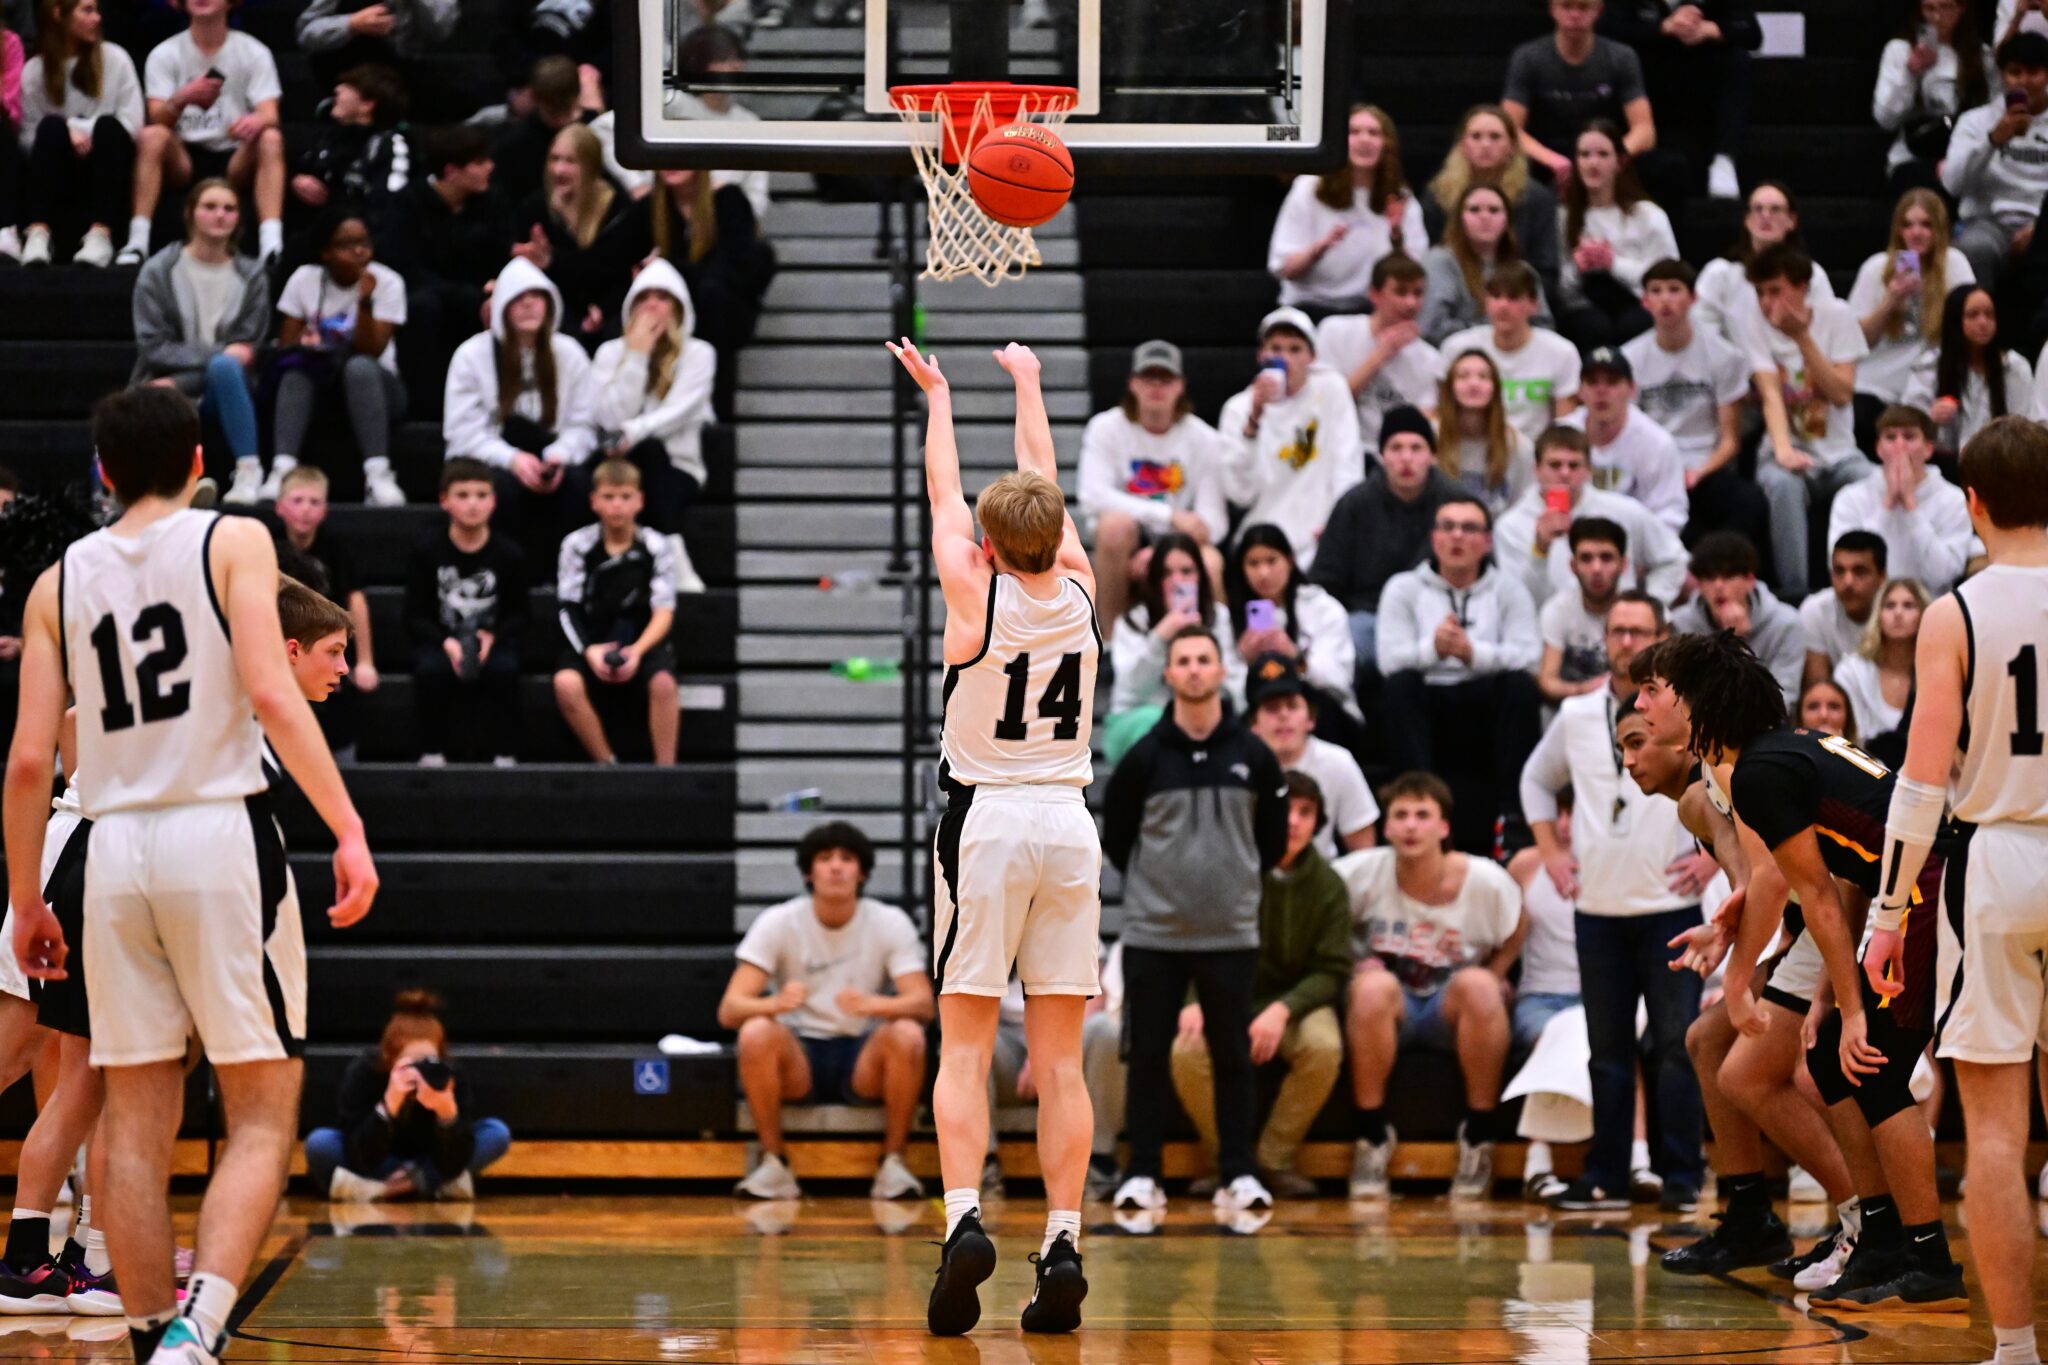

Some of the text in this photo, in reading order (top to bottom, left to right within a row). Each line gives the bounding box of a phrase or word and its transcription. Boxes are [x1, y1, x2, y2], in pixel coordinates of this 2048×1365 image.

[91, 602, 191, 733] 12
[994, 651, 1082, 741] 14
[1818, 735, 1891, 779] 1
